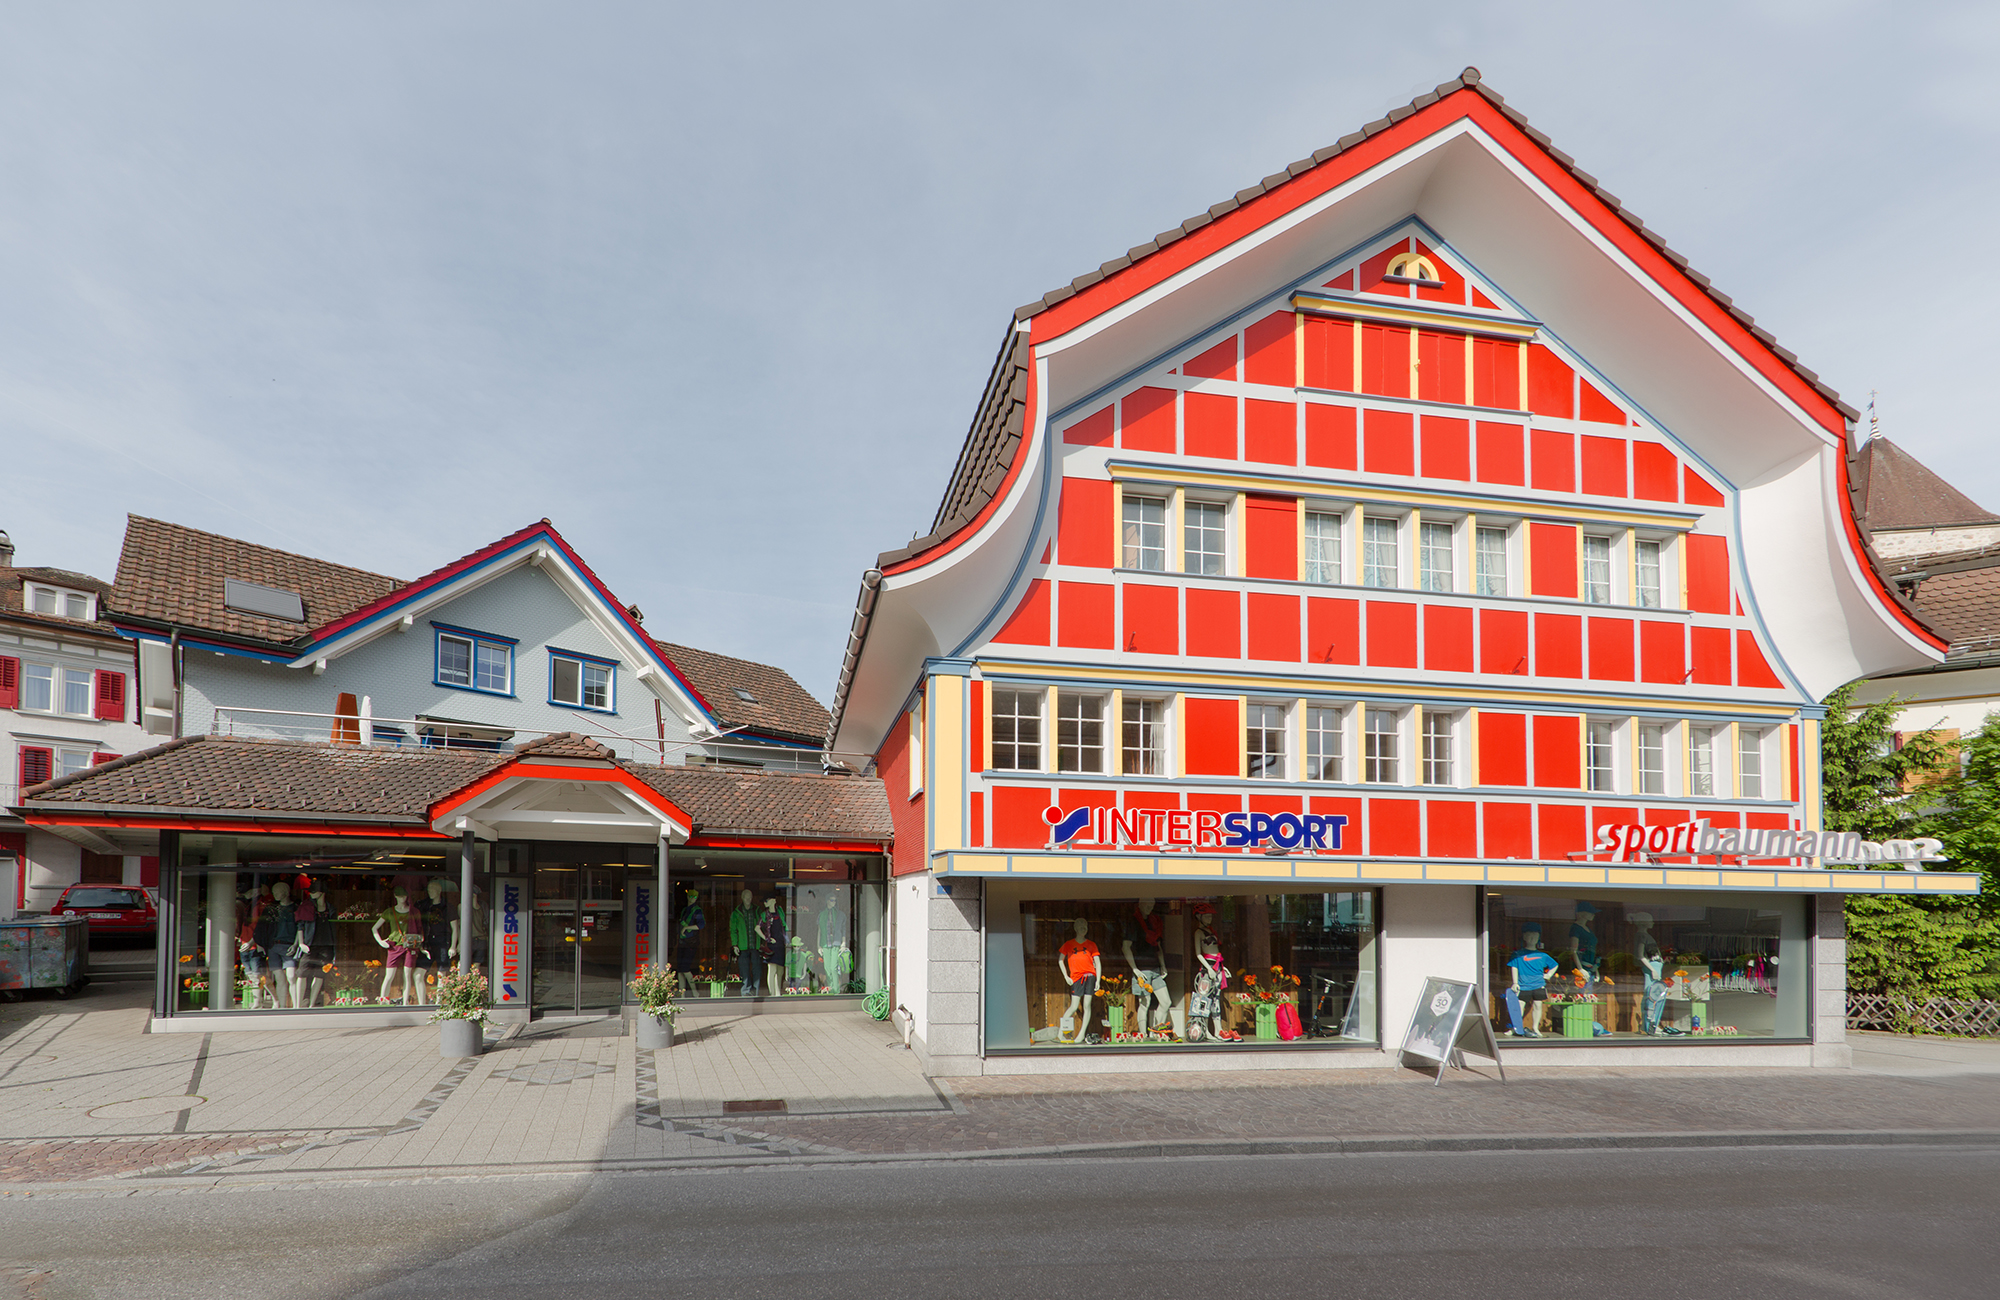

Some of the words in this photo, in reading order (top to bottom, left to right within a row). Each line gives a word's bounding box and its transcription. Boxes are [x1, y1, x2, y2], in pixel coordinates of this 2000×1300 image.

[1094, 806, 1348, 849] INTERSPORT
[1596, 818, 1862, 863] sportbaumann
[503, 884, 519, 982] INTERSPORT
